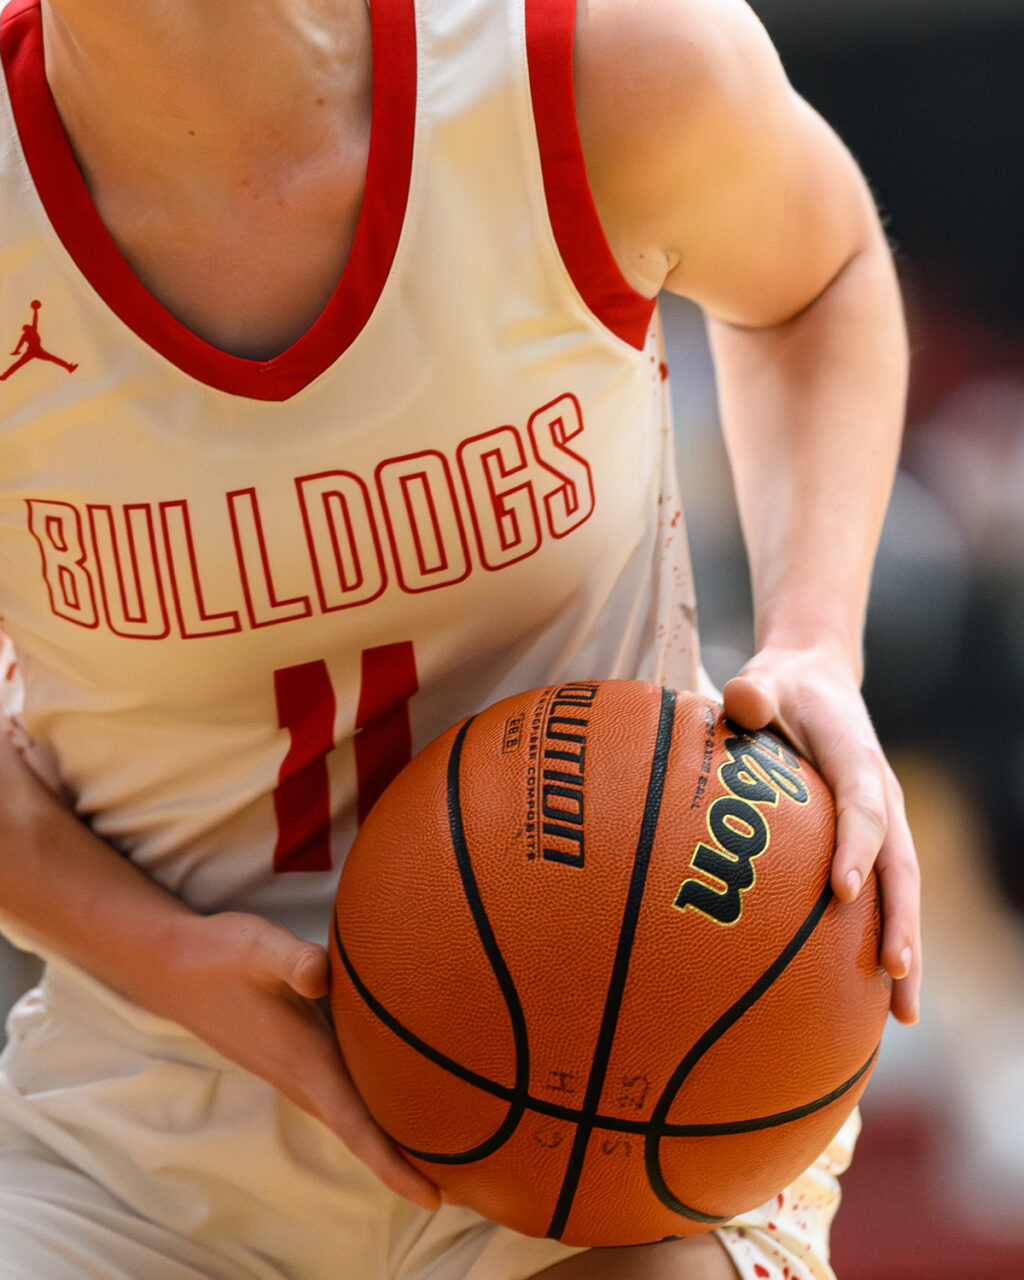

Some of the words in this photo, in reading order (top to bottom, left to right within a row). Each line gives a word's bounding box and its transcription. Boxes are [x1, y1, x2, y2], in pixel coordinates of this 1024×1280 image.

[25, 392, 595, 640] BULLDOGS
[273, 640, 419, 874] 11
[526, 767, 536, 861] COMPOSITE
[542, 683, 601, 868] OLUTION
[672, 720, 809, 927] ilson
[691, 776, 708, 810] BALL
